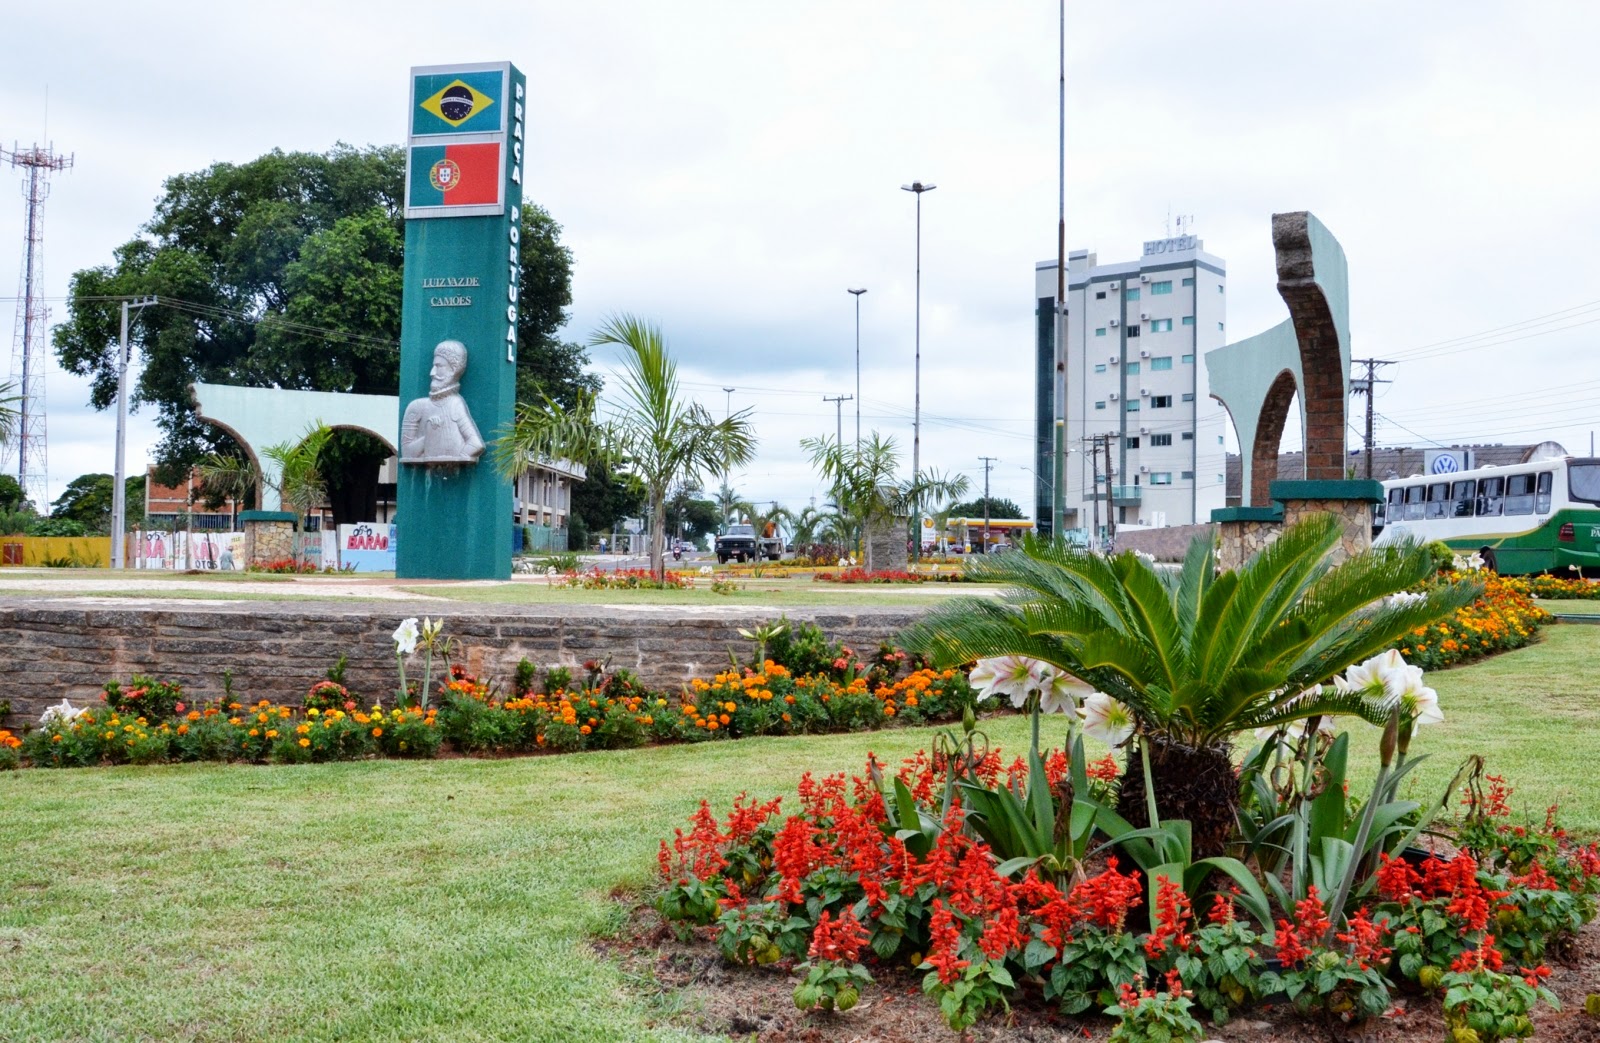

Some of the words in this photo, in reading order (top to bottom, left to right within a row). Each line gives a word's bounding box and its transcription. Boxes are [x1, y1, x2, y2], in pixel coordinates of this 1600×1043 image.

[513, 82, 523, 185] PRAÇA
[1144, 237, 1196, 255] HOTEL
[422, 278, 445, 288] LUIZ
[447, 277, 465, 287] VAZ
[466, 277, 480, 287] DE
[507, 205, 519, 363] PORTUGAL
[430, 293, 471, 307] CAMÕES
[347, 533, 388, 550] BARÃO
